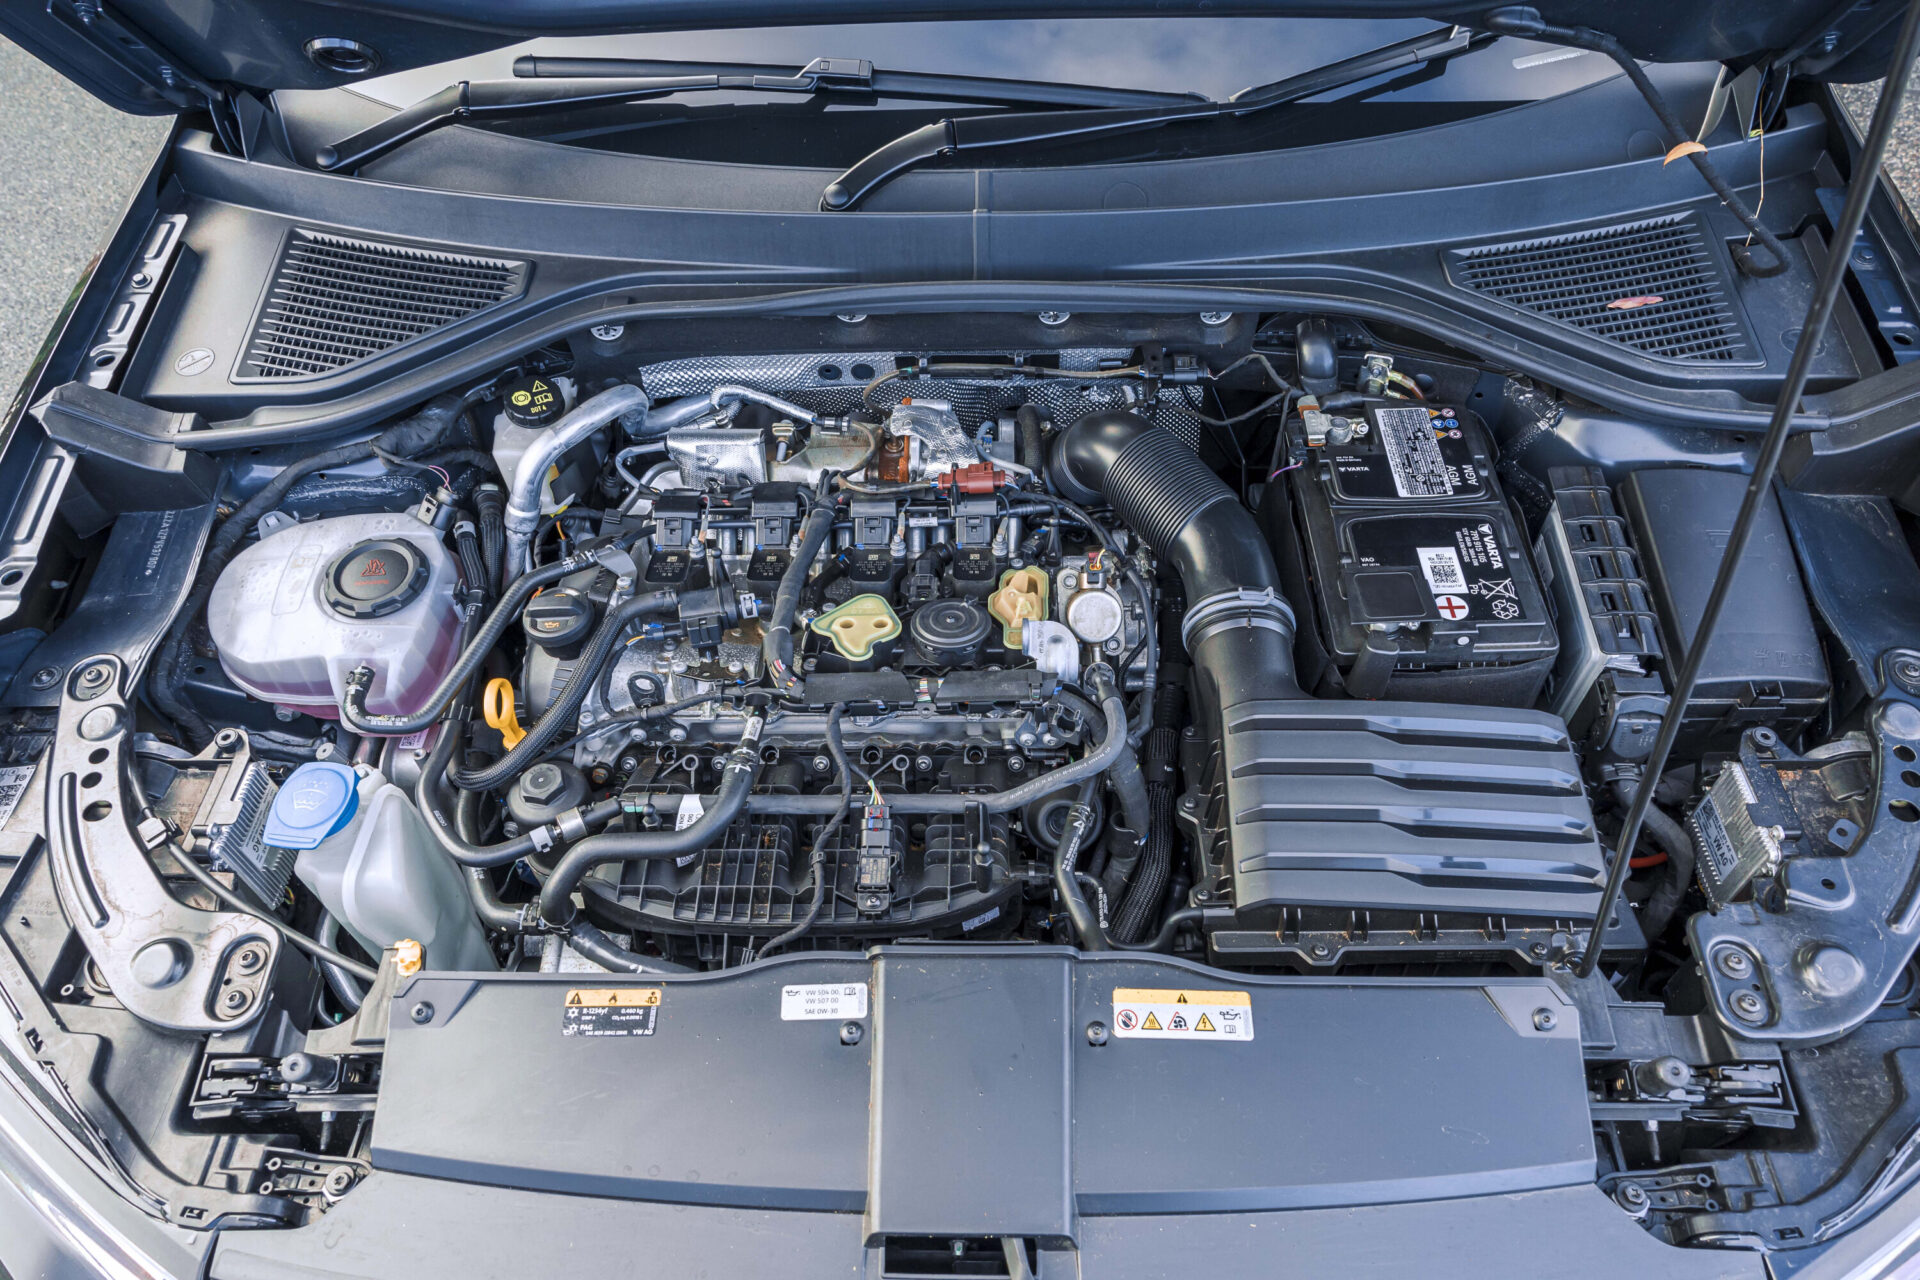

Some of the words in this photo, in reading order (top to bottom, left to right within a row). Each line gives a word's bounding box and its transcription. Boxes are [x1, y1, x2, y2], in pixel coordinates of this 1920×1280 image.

[530, 406, 542, 414] DOT
[1446, 465, 1462, 486] AGM
[1462, 464, 1478, 486] AGM
[1470, 530, 1480, 541] 7P0
[1474, 541, 1484, 552] 915
[1483, 535, 1504, 569] VARTA
[1478, 552, 1488, 562] 105
[1469, 584, 1480, 595] Pb
[253, 837, 262, 853] AG
[1713, 836, 1723, 851] VW
[1719, 852, 1729, 867] AG
[582, 1007, 609, 1016] R-1234yf
